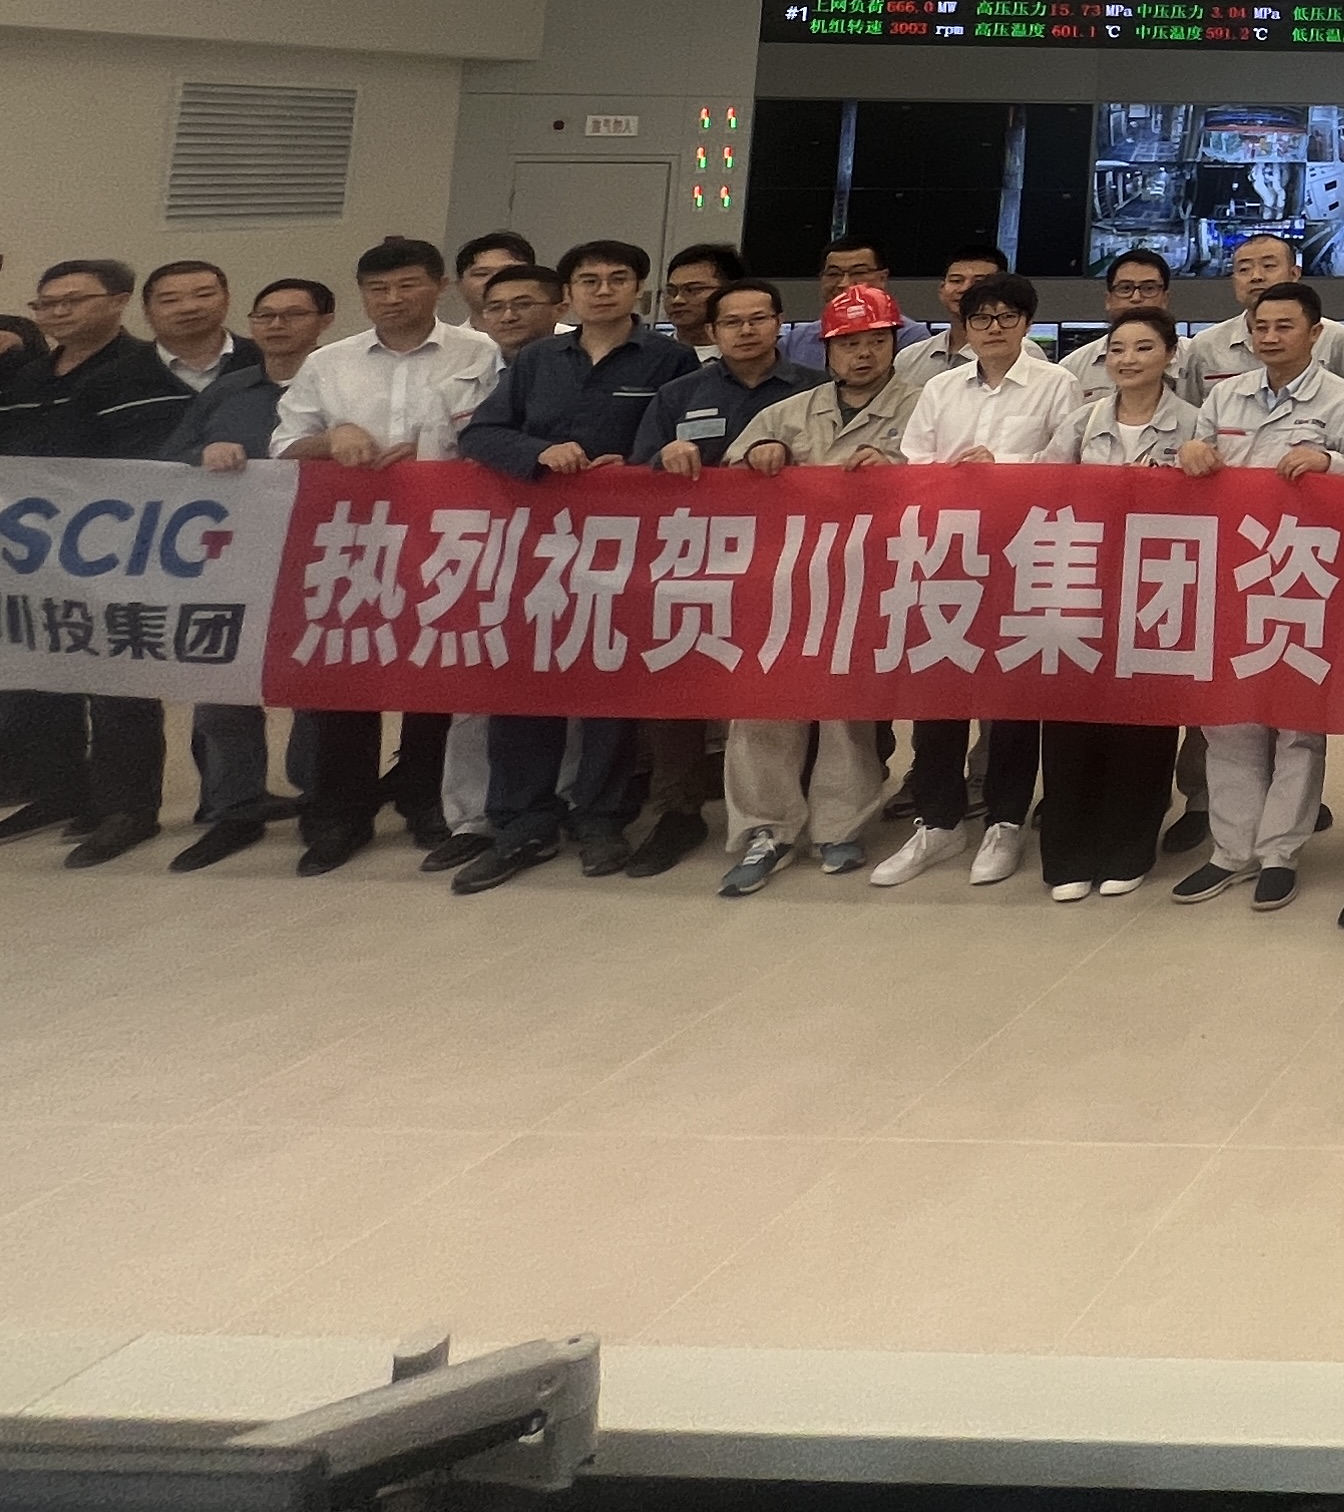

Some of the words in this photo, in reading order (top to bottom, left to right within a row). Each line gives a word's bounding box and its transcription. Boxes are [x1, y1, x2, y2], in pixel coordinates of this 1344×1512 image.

[785, 5, 808, 22] #1
[937, 1, 957, 14] MW
[976, 0, 1047, 16] 高压压力
[1105, 4, 1133, 17] MPa
[1137, 3, 1203, 19] 中压压力
[1253, 7, 1281, 20] MPa
[810, 19, 883, 34] 机组转速
[935, 25, 964, 37] rpm
[975, 22, 1046, 37] 高压温度
[1135, 24, 1203, 40] 中压温度
[0, 497, 234, 578] SCIG
